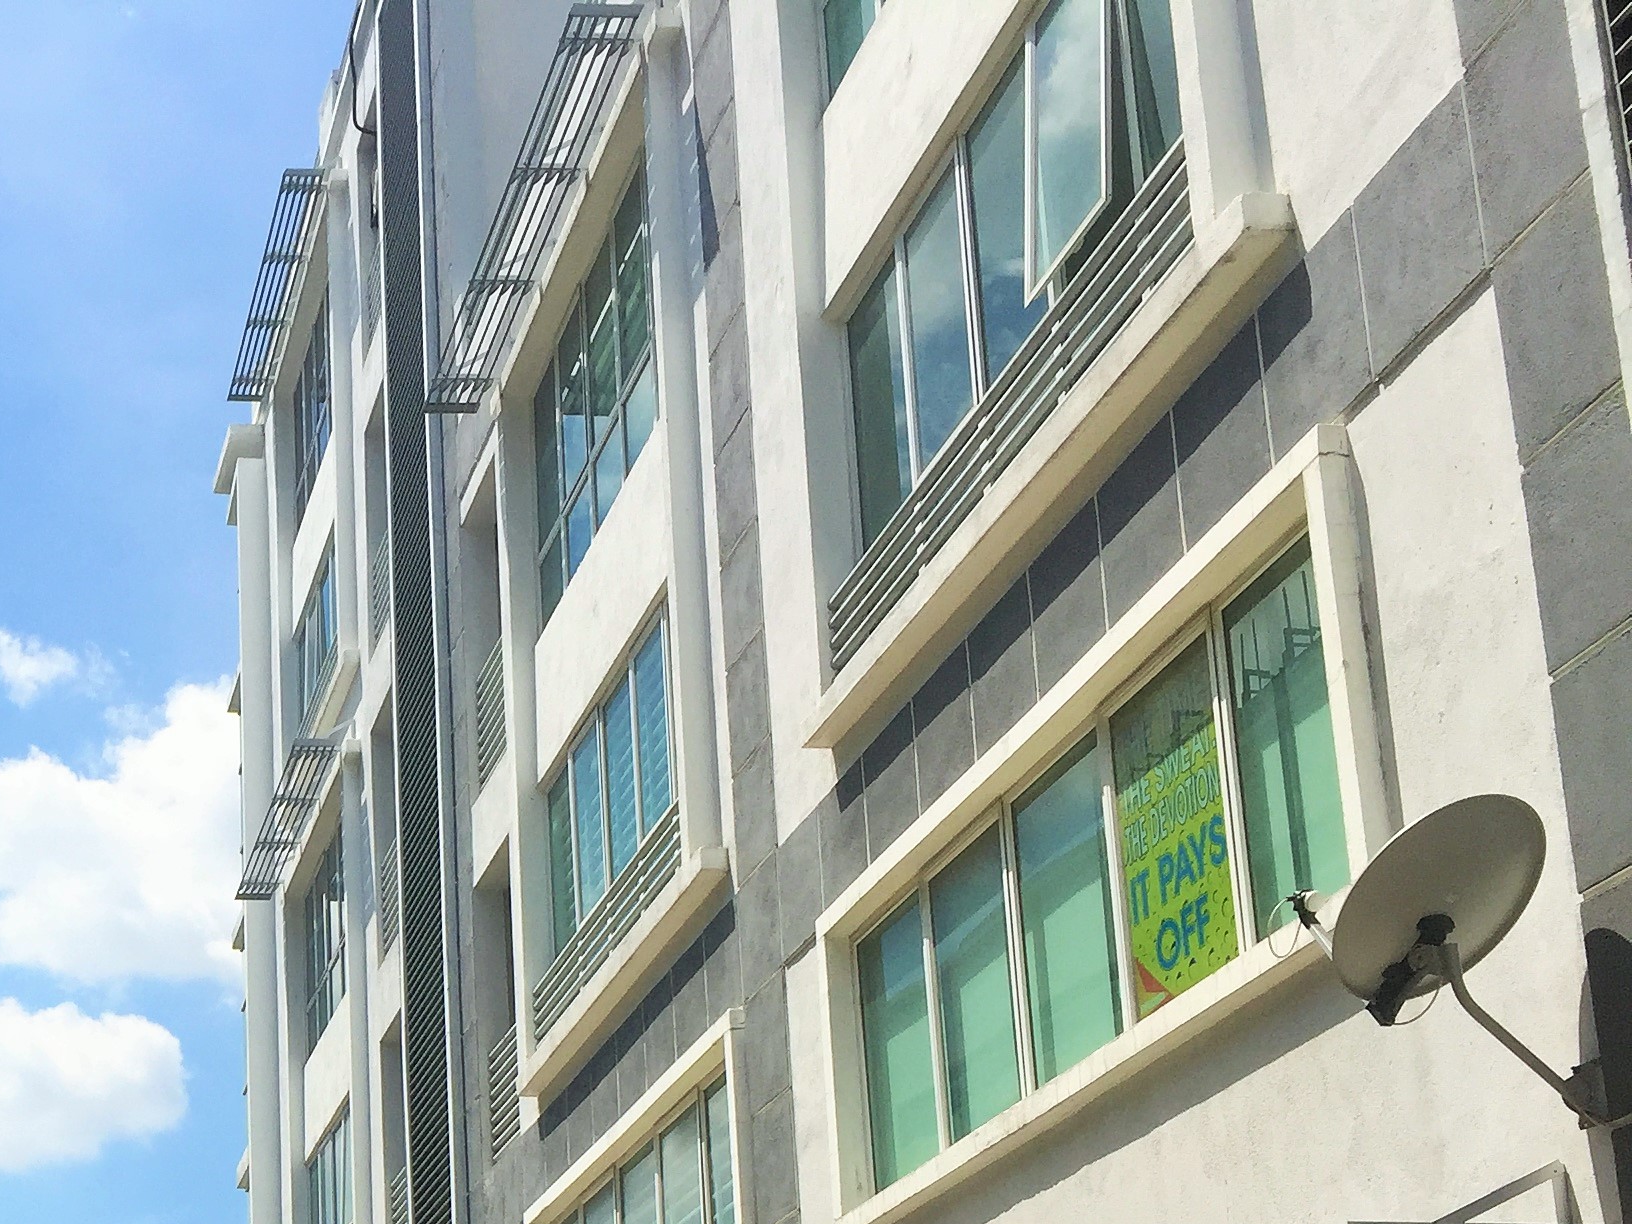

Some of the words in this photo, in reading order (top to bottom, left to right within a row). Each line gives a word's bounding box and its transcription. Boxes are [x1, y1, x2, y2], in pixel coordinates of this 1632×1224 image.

[1123, 776, 1151, 819] THE
[1124, 815, 1149, 868] THE
[1150, 760, 1221, 848] DEVOTION
[1129, 867, 1150, 926] IT
[1157, 815, 1228, 906] PAYS
[1156, 892, 1210, 971] OFF
